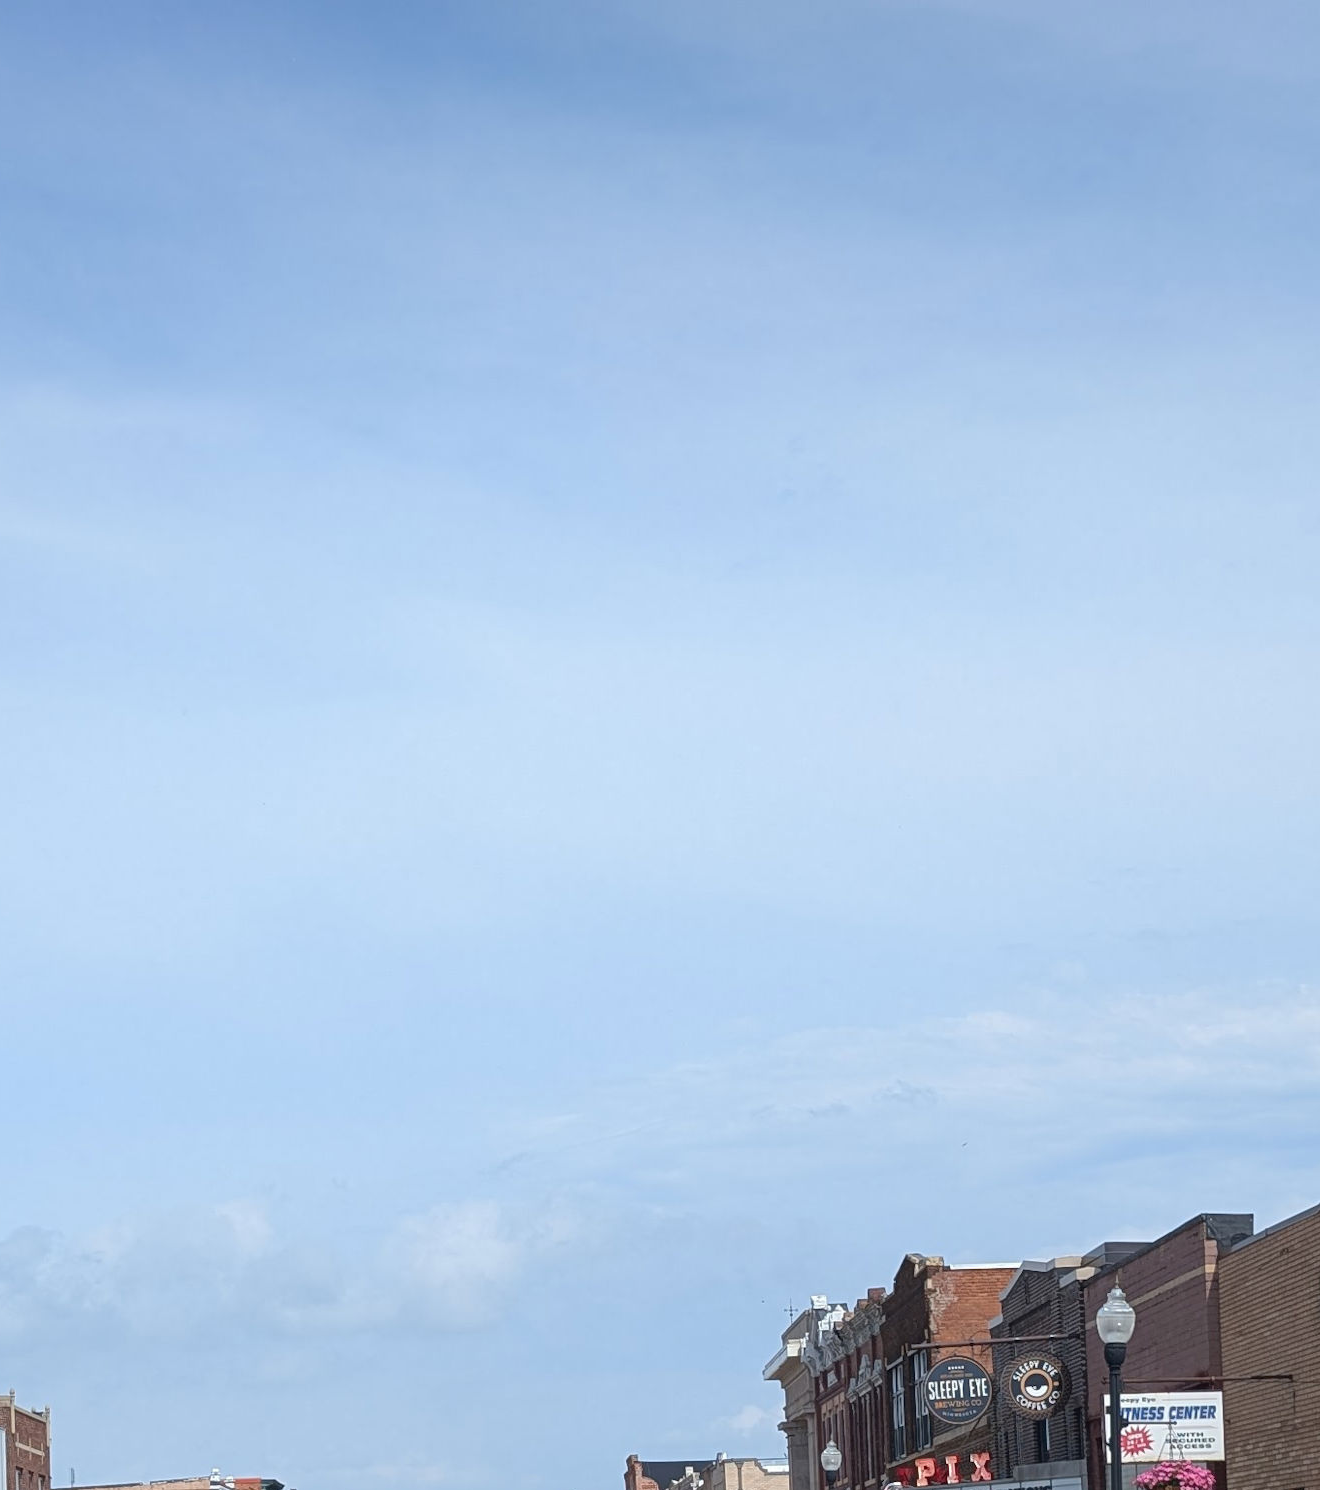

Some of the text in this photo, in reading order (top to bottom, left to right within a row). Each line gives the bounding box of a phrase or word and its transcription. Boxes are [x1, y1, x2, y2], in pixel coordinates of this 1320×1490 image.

[1013, 1360, 1058, 1381] SLEEPY EYE
[928, 1378, 988, 1400] SLEEPY EYE
[934, 1400, 970, 1409] BREWING
[1016, 1394, 1047, 1411] COFFEE
[1120, 1405, 1217, 1420] ITNESS CENTER
[914, 1452, 992, 1487] PIX
